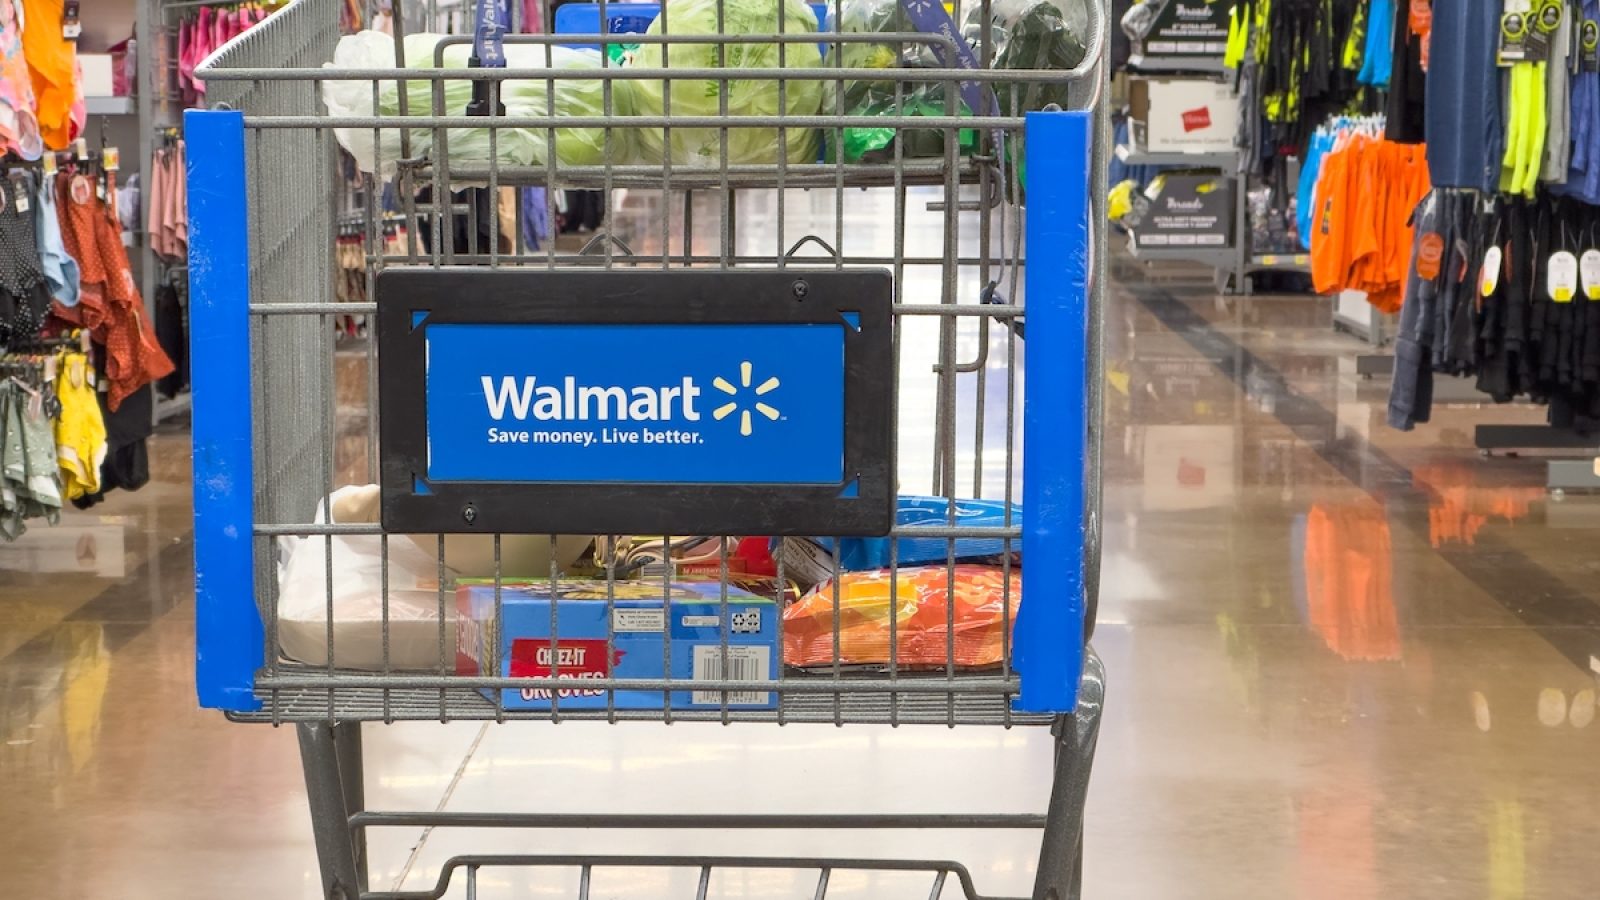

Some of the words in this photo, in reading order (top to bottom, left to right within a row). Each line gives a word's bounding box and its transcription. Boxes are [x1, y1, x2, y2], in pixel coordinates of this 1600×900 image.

[481, 375, 701, 421] Walmart
[488, 428, 529, 444] Save
[533, 430, 597, 447] money.
[602, 428, 639, 444] Live
[643, 428, 704, 444] better.
[536, 647, 586, 666] CHEZ-IT
